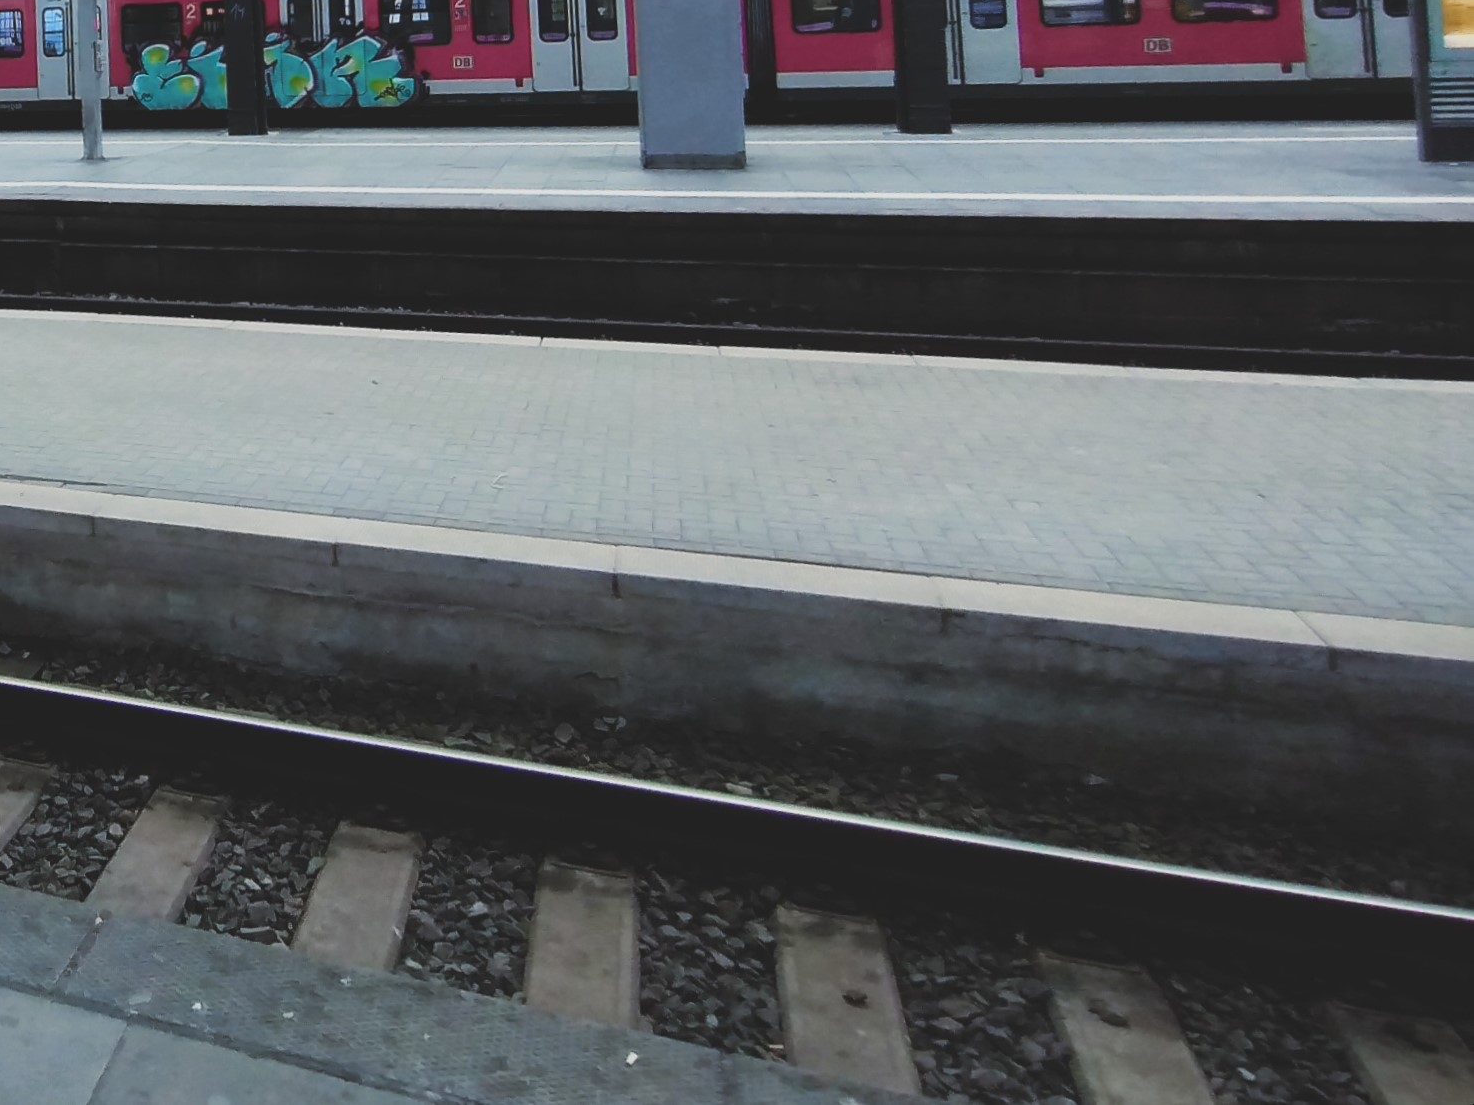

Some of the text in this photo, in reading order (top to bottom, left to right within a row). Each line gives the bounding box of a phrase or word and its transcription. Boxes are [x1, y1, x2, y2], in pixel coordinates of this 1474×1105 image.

[186, 3, 197, 19] 2
[1145, 39, 1171, 52] DB
[454, 57, 472, 68] DB
